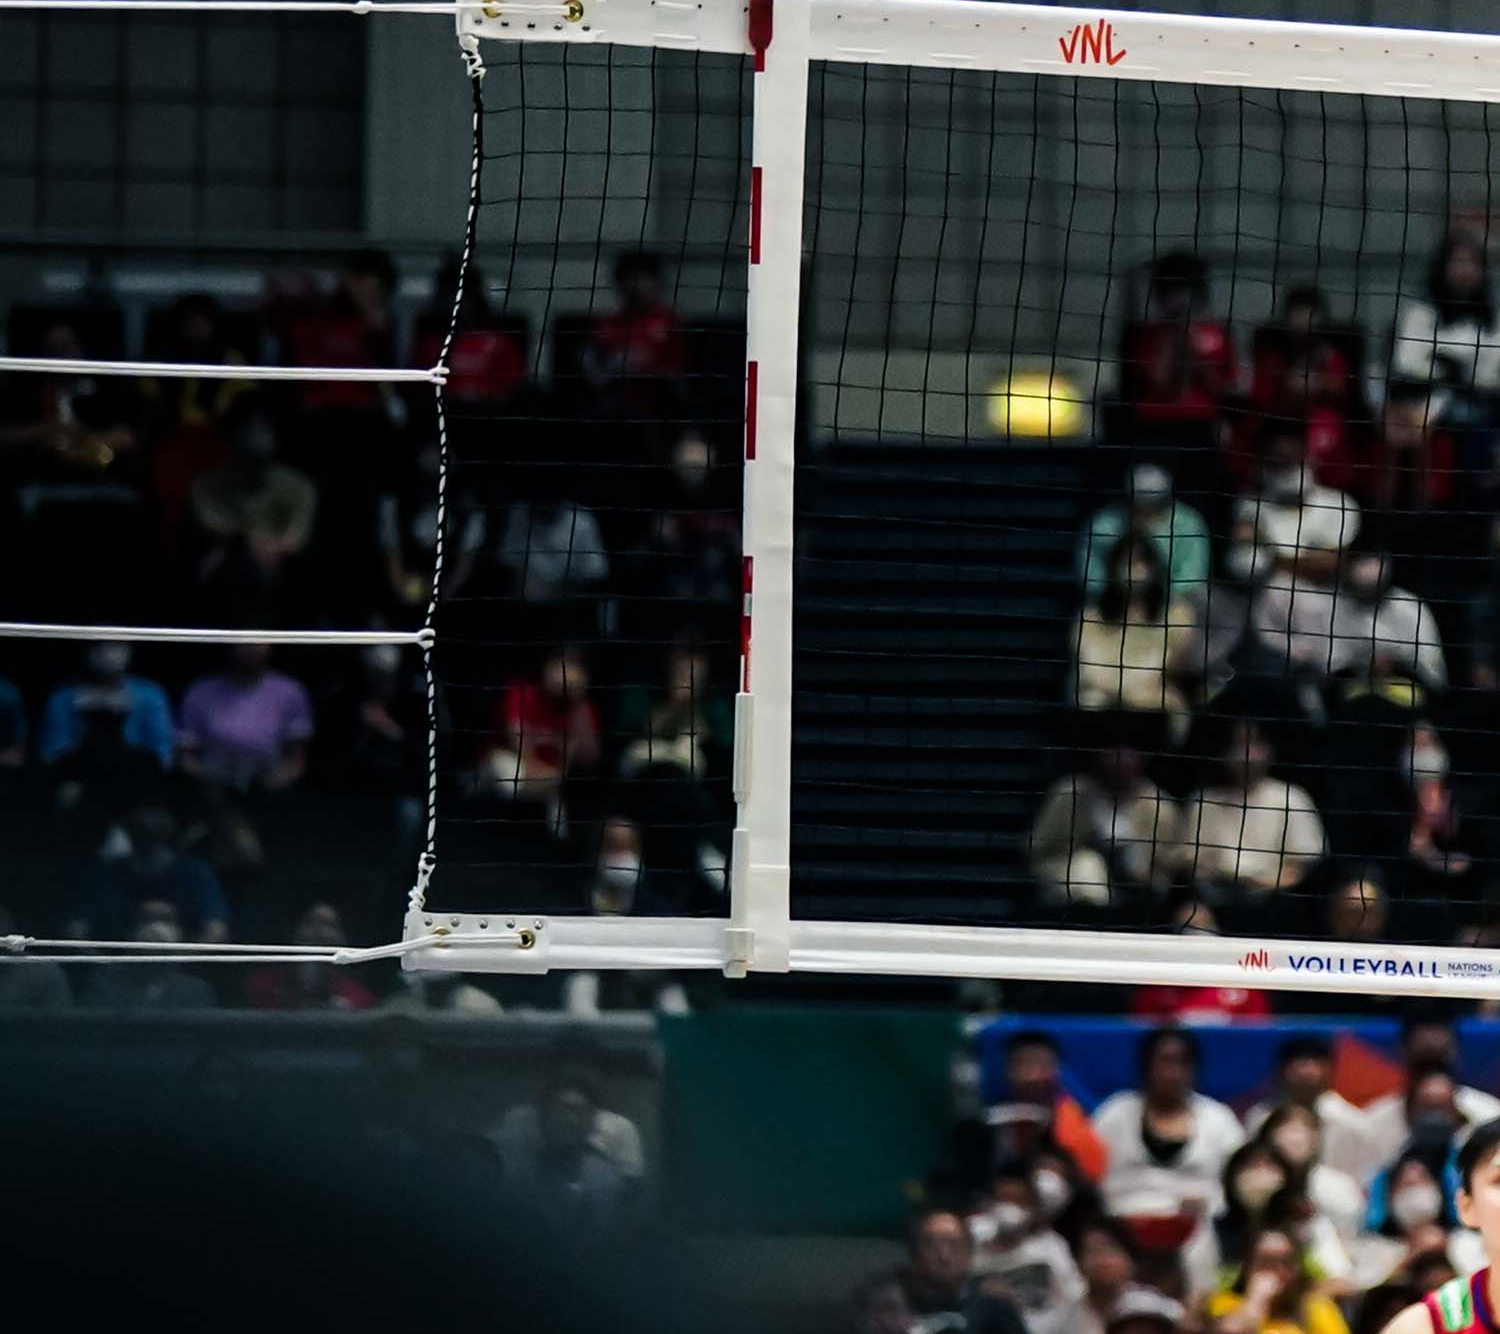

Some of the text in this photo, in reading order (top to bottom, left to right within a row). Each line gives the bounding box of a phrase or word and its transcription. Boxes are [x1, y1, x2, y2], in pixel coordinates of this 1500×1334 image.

[1058, 18, 1128, 66] VNL
[1288, 955, 1444, 979] VOLLEYBALL
[1448, 962, 1493, 973] NATIONS
